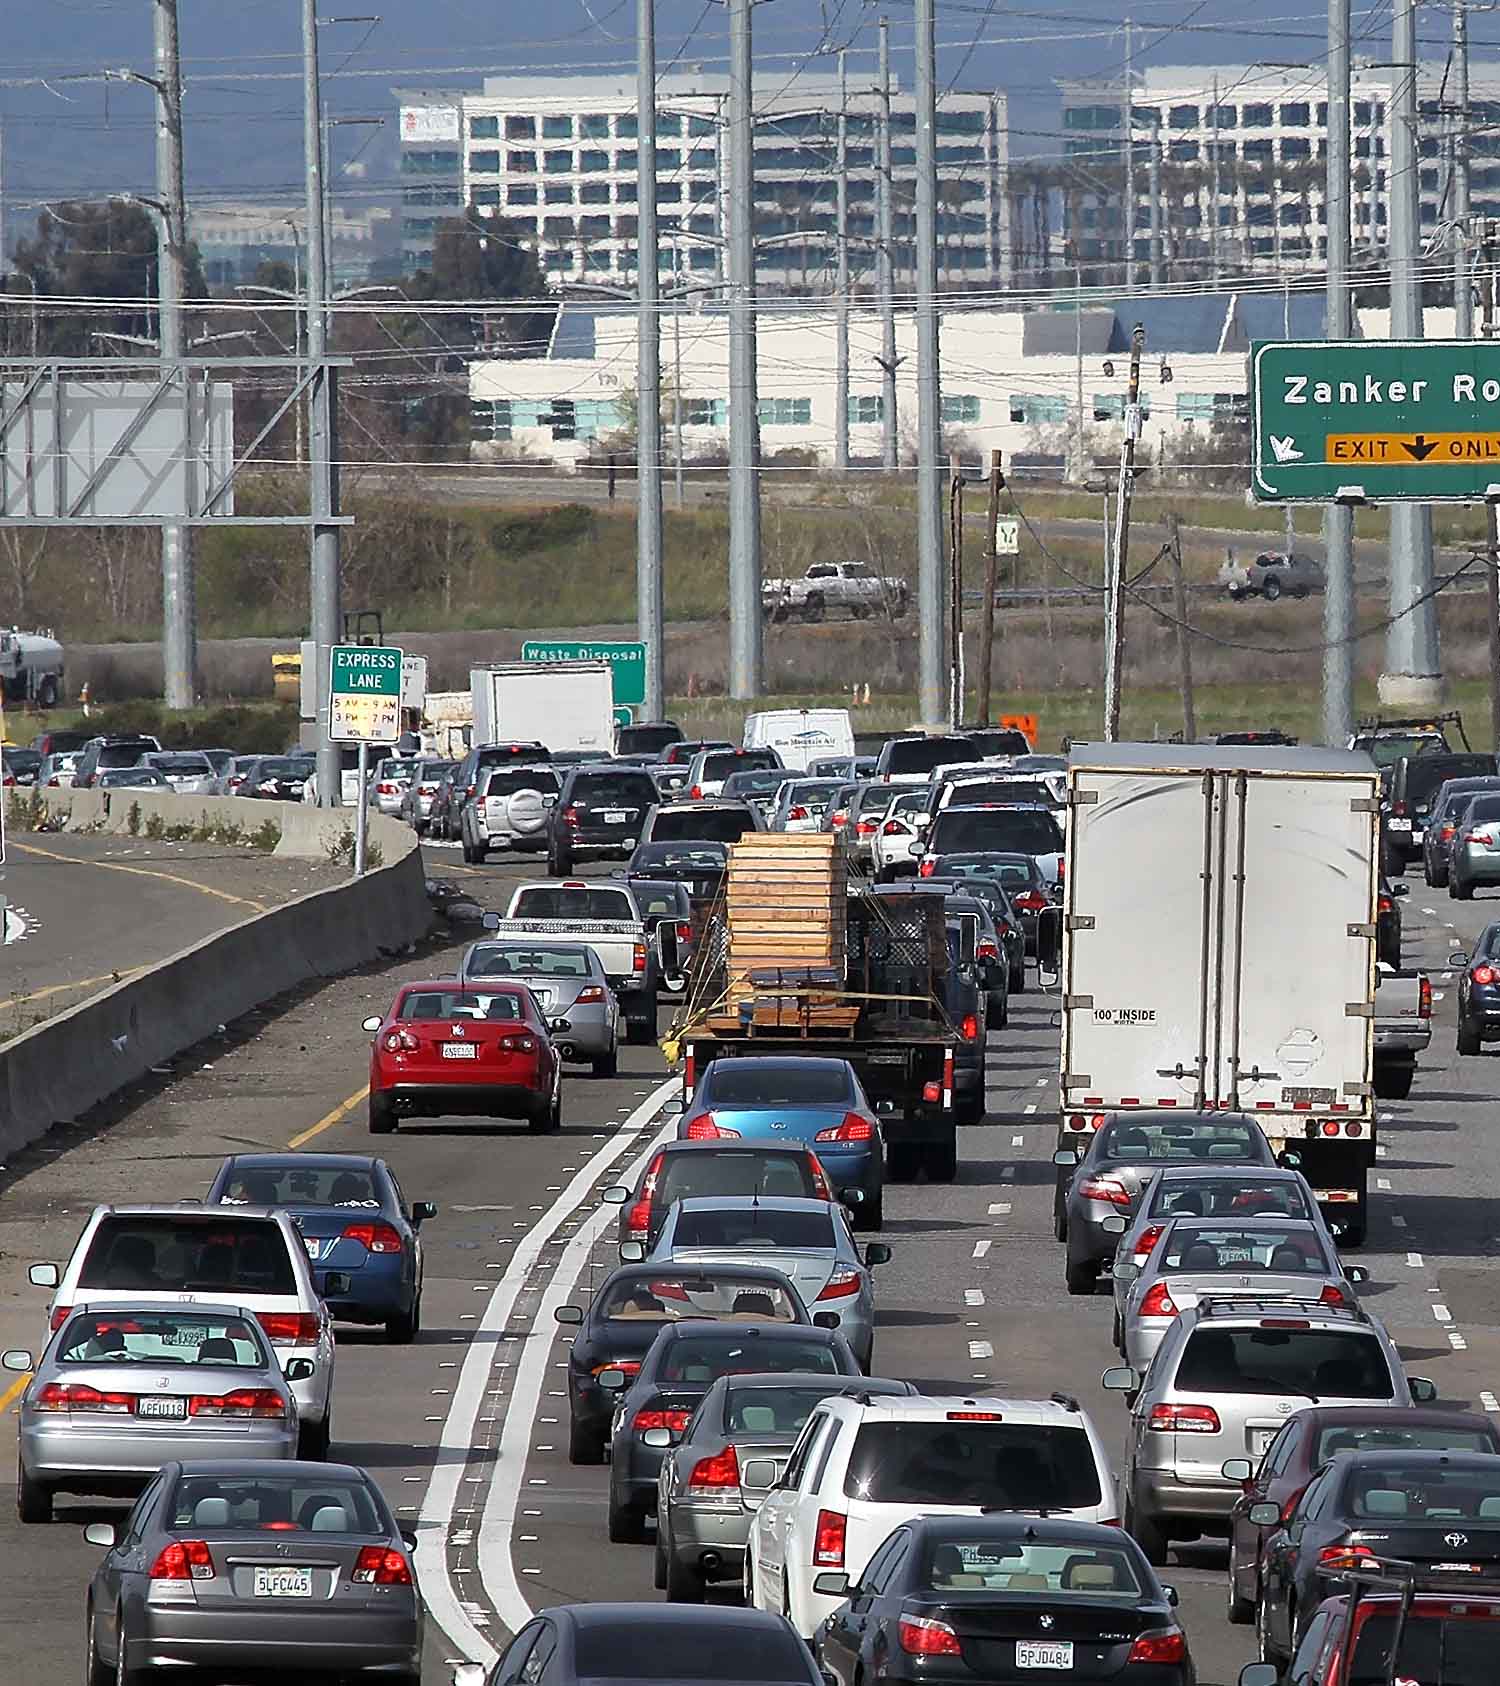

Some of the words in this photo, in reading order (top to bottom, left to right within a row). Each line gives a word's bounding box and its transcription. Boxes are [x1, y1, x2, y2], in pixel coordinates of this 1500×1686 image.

[1284, 375, 1428, 404] Zanker
[1334, 440, 1388, 458] EXIT
[337, 653, 396, 669] EXPRESS
[527, 648, 570, 660] Waste
[579, 648, 642, 661] Disposal
[349, 673, 382, 688] LANE
[334, 698, 341, 708] 5
[383, 701, 396, 710] AM
[335, 713, 341, 722] 3
[382, 714, 395, 724] PM
[1119, 1009, 1156, 1021] INSIDE
[258, 1578, 308, 1592] 5LFC445
[1020, 1649, 1069, 1665] 5PJD484
